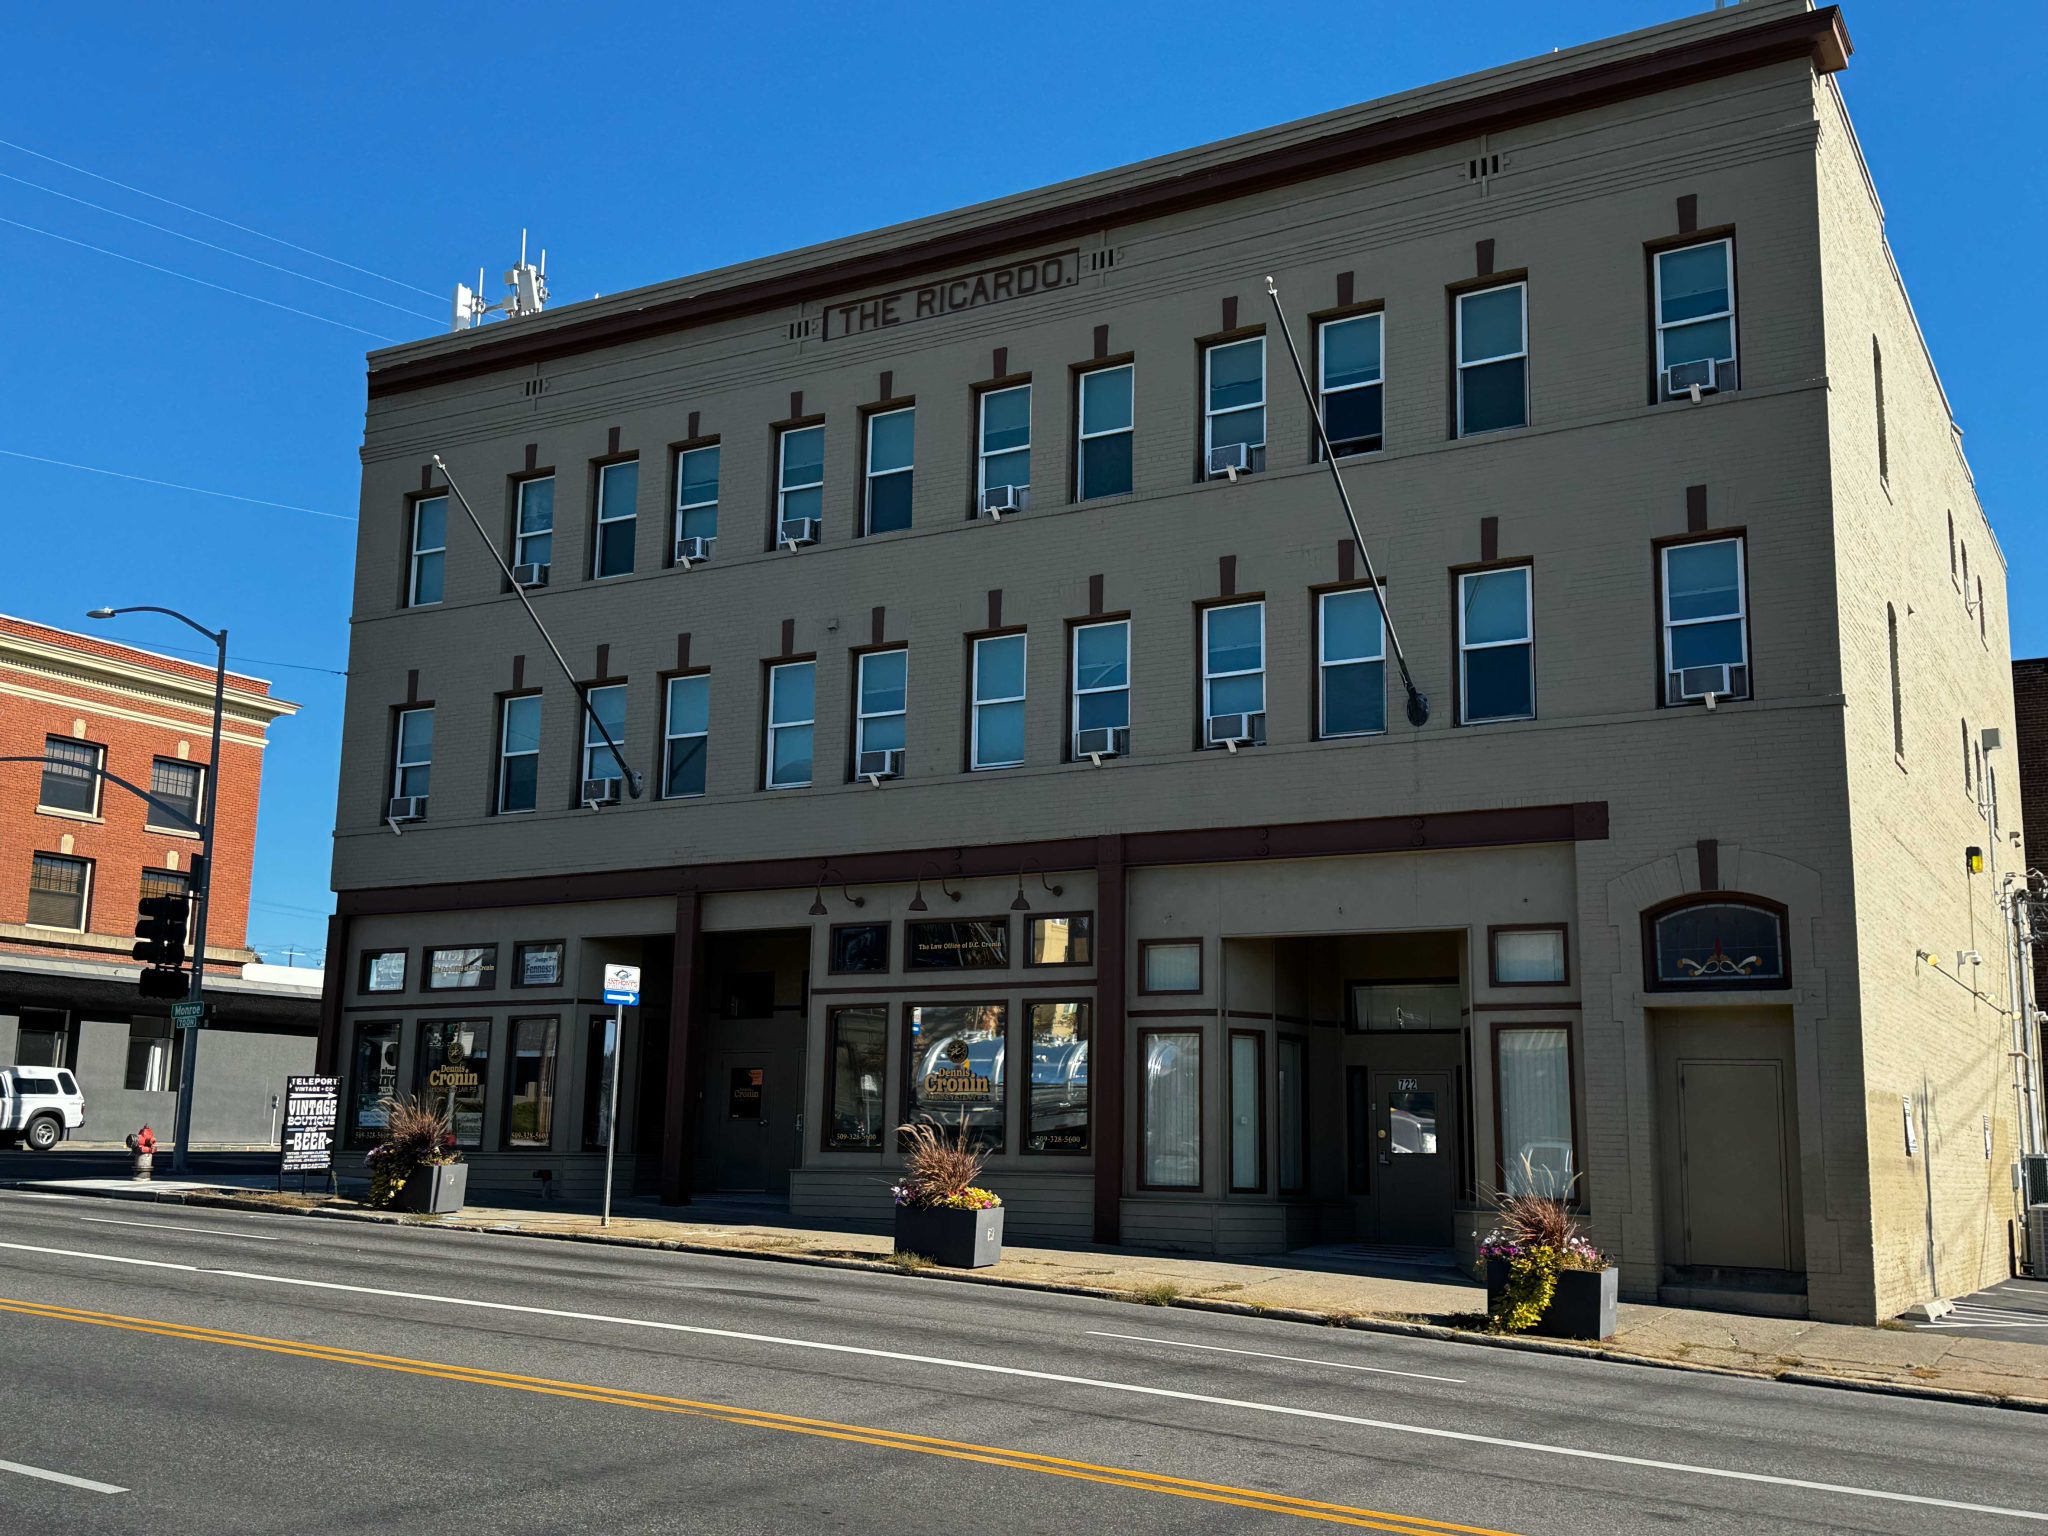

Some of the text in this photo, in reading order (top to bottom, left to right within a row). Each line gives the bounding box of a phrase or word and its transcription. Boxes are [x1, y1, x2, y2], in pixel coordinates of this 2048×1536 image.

[839, 258, 1073, 335] THE RICARDO.
[918, 943, 930, 951] The
[943, 942, 961, 950] Office
[175, 1005, 201, 1017] Monroe
[441, 1064, 465, 1074] Dennis
[938, 1067, 971, 1078] Dennis
[429, 1069, 479, 1086] Cronin
[924, 1072, 991, 1094] Cronin
[1399, 1079, 1417, 1090] 722
[288, 1099, 338, 1116] VINTAGE
[287, 1115, 336, 1127] BOUTIQUE
[293, 1132, 327, 1151] BEER
